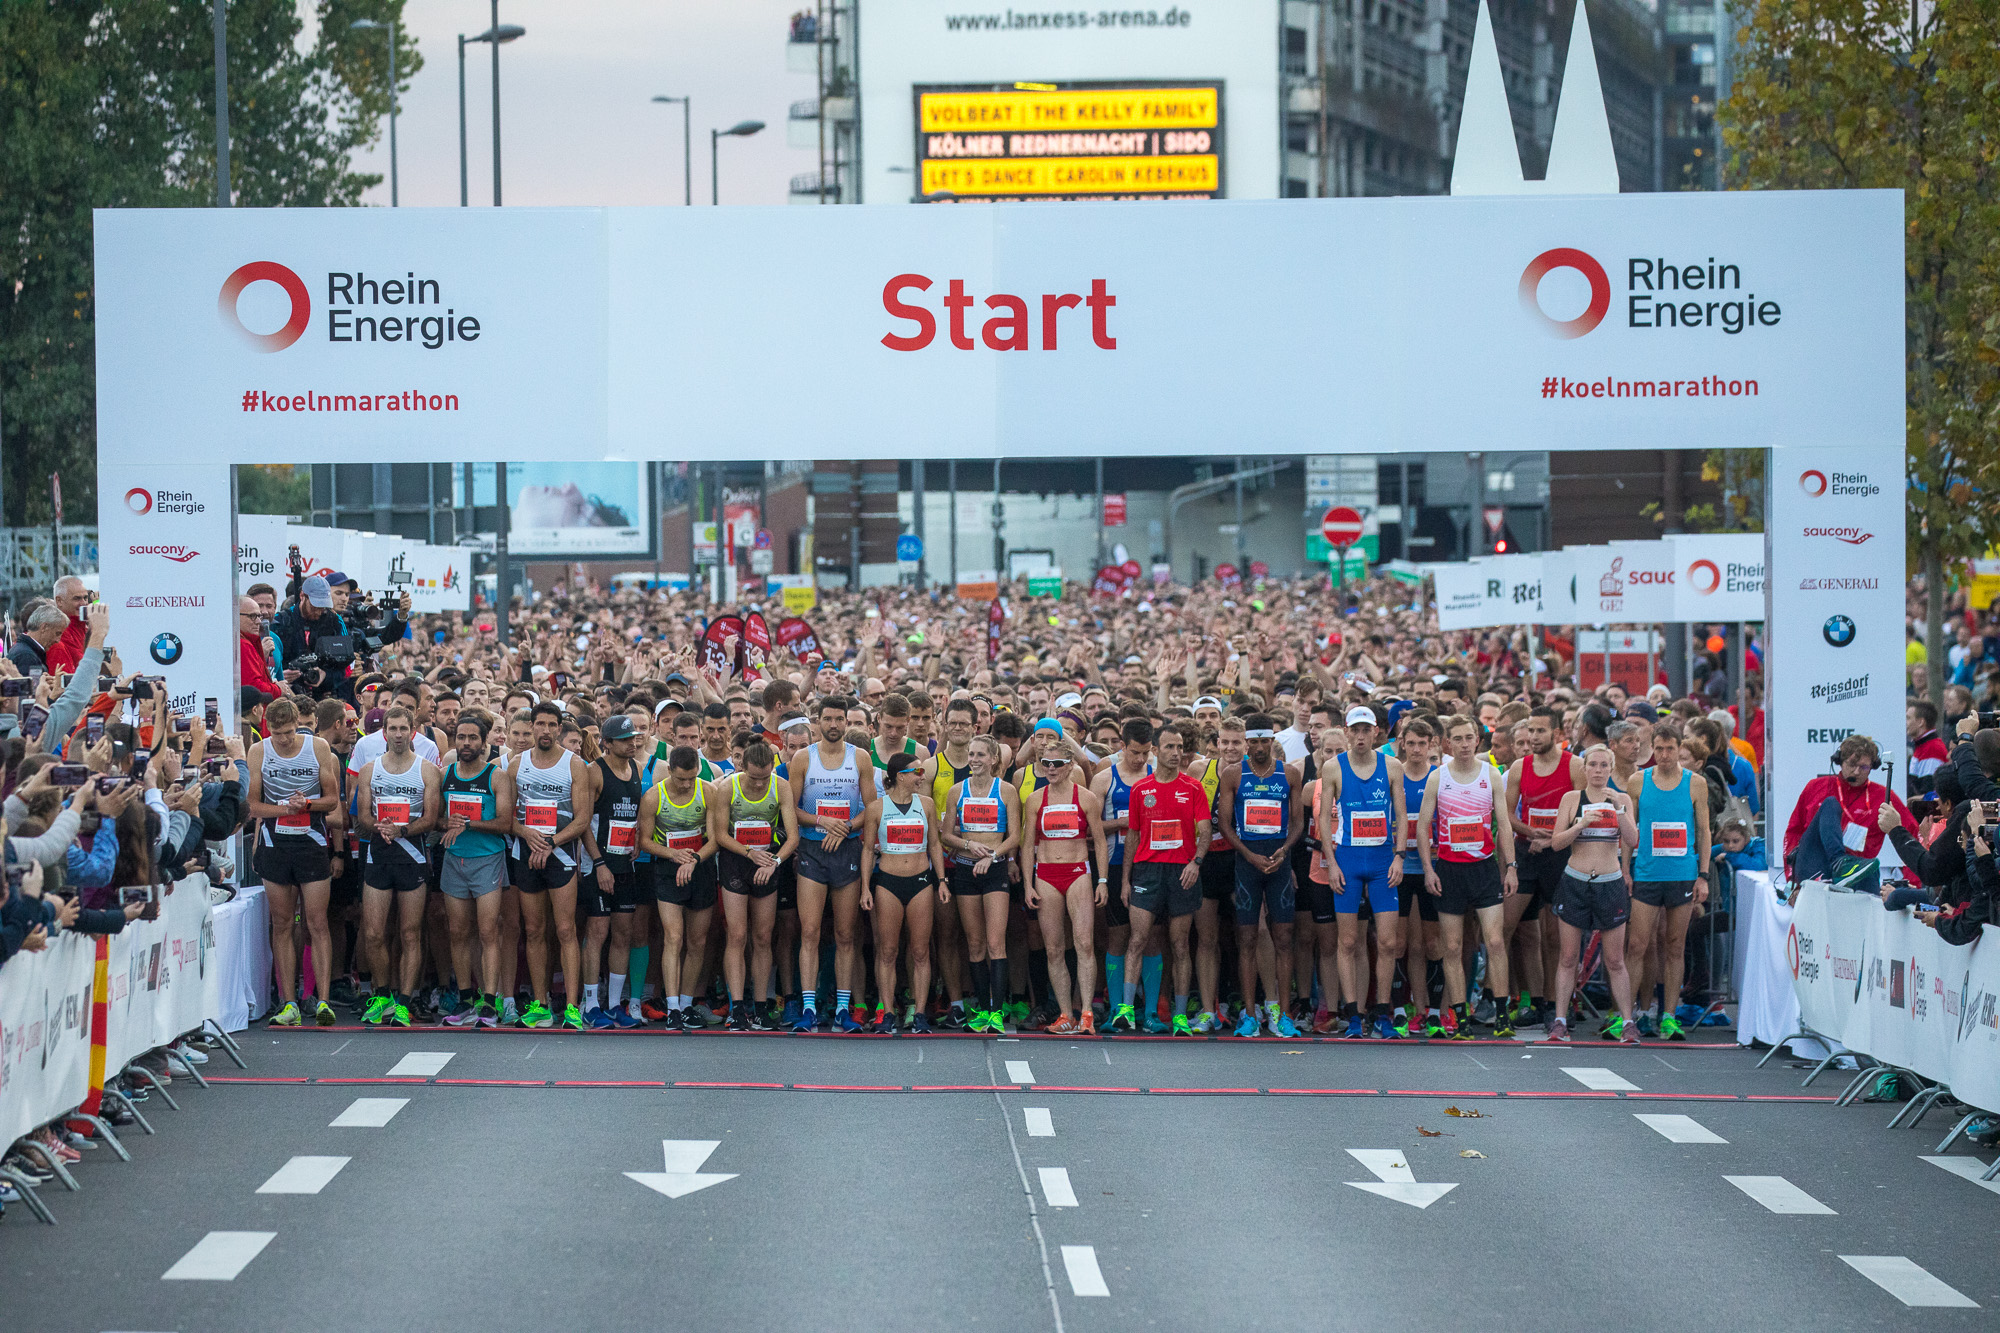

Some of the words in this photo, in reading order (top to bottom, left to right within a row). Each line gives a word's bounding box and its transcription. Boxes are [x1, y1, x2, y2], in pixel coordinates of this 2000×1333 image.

[945, 7, 1192, 31] www.lanxess-arena.de
[930, 105, 1012, 123] VOLBEAT
[1034, 105, 1068, 121] THE
[1078, 104, 1132, 120] KELLY
[1143, 102, 1209, 119] FAMILY
[927, 131, 1004, 157] KÖLNER
[1164, 131, 1211, 154] SIDO
[983, 167, 1034, 184] DANCE
[1055, 165, 1125, 184] CAROLIN
[1628, 257, 1741, 290] Rhein
[328, 271, 440, 305] Rhein
[880, 273, 1117, 352] Start
[1628, 294, 1782, 335] Energie
[328, 308, 481, 350] Energie
[1541, 375, 1759, 399] #koelnmarathon
[242, 389, 460, 412] #koelnmarathon
[1832, 472, 1867, 483] Rhein
[157, 490, 193, 502] Rhein
[1832, 484, 1880, 497] Energie
[157, 502, 205, 515] Energie
[1803, 527, 1859, 538] saucony
[129, 545, 185, 556] saucony
[1727, 578, 1765, 595] Ener
[1818, 578, 1879, 590] GENERALI
[145, 596, 205, 608] GENERALI
[1826, 615, 1853, 627] BMW
[153, 633, 180, 646] BMW
[1810, 673, 1869, 699] Reissdorf
[166, 690, 197, 710] sdorf
[1826, 688, 1868, 704] ALKOHOLFREI
[269, 769, 279, 778] LT
[291, 767, 313, 777] DSHS
[375, 786, 384, 794] LT
[396, 786, 418, 795] DSHS
[542, 784, 563, 793] DSHS
[454, 802, 475, 811] Idriss
[528, 808, 552, 816] Hakim
[970, 806, 990, 815] Katja
[891, 827, 922, 835] Sabrina
[1455, 825, 1478, 833] David
[1798, 931, 1814, 955] Rhein
[1800, 955, 1820, 984] Energie
